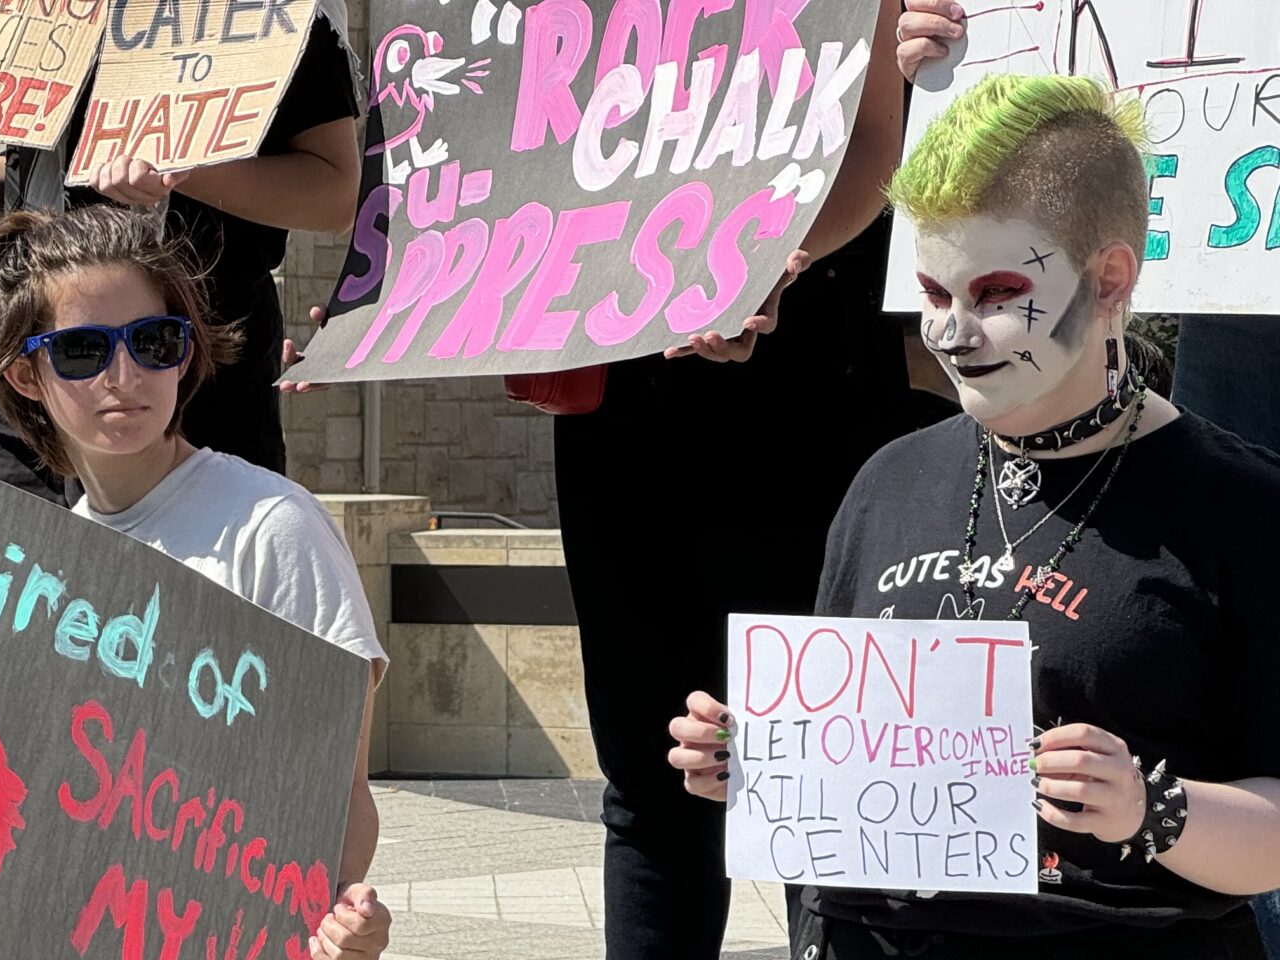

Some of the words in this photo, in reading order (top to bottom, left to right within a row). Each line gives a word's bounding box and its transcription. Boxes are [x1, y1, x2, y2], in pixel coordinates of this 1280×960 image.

[173, 52, 212, 83] TO
[73, 81, 277, 176] HATE
[572, 38, 870, 191] CHALK
[878, 550, 960, 592] CUTE
[972, 555, 1012, 588] AS
[1014, 565, 1088, 621] HELL
[745, 625, 1024, 718] DON'T
[743, 719, 812, 762] LET
[961, 758, 1029, 779] IANCE
[745, 770, 837, 823] KILL
[857, 780, 978, 826] OUR
[769, 825, 1029, 880] CENTERS
